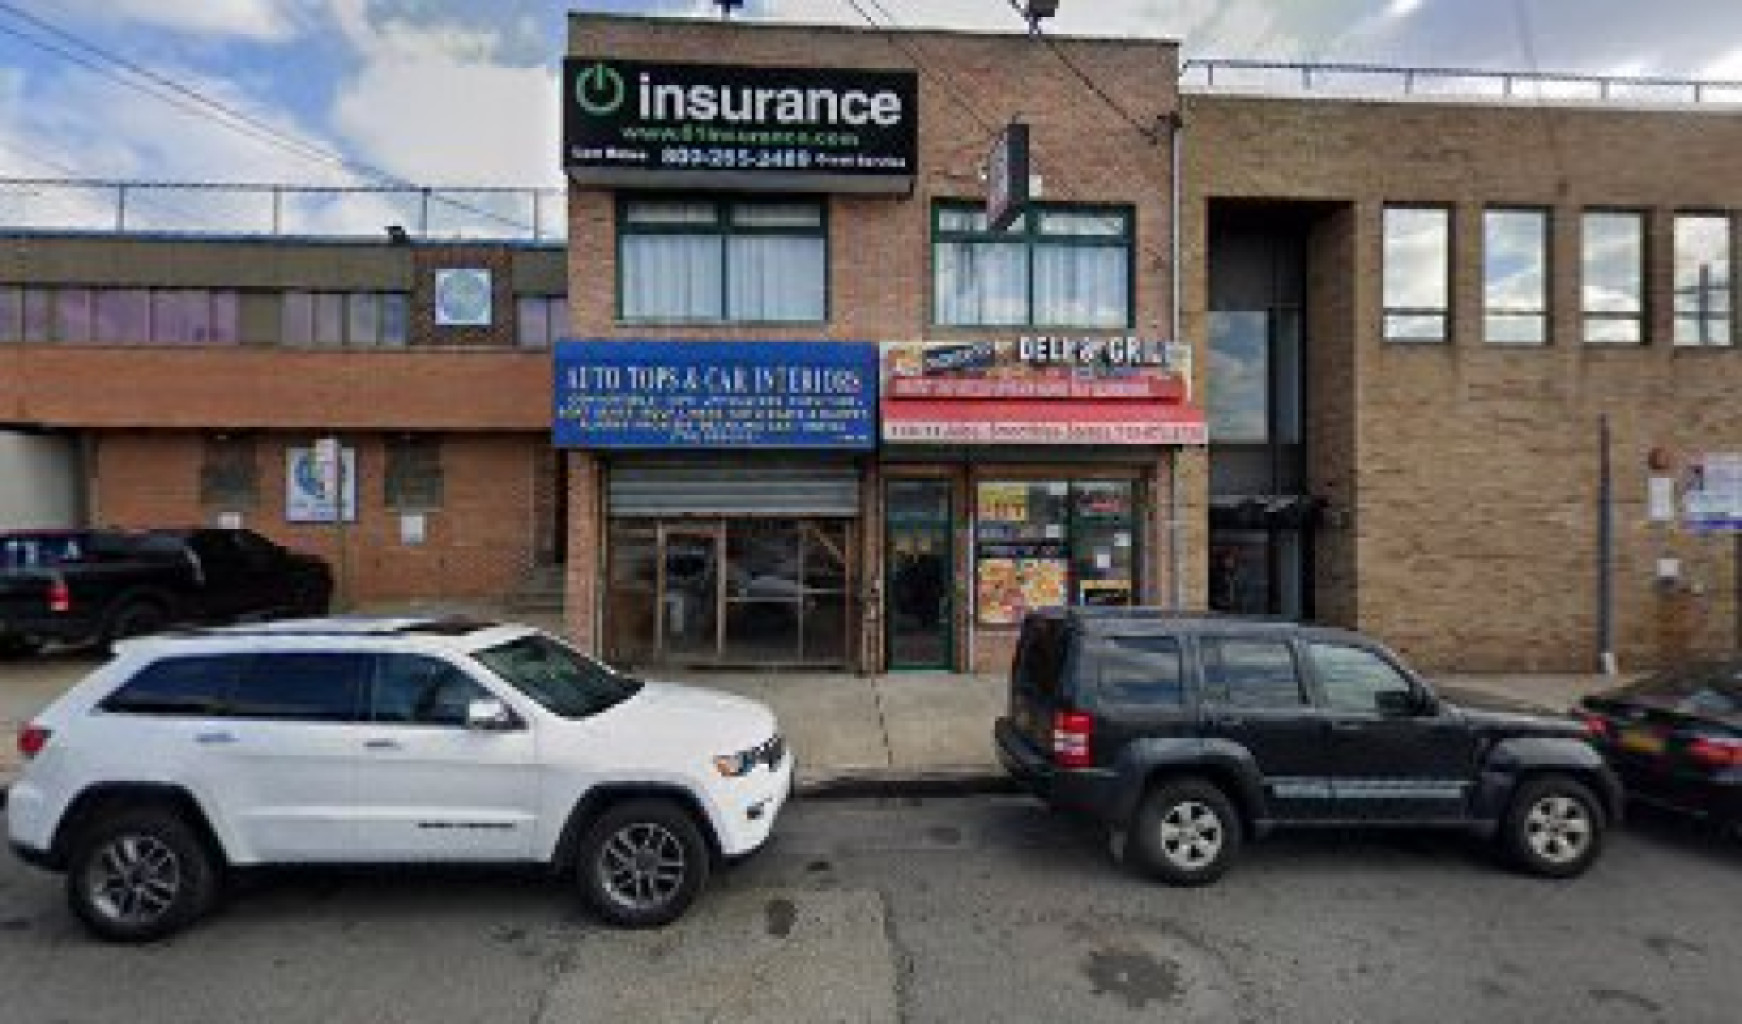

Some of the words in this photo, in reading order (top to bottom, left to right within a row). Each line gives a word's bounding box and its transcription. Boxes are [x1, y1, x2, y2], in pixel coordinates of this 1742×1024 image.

[638, 72, 902, 125] insurance
[567, 367, 620, 389] AUTO
[627, 367, 676, 392] TOPS
[704, 367, 749, 393] CAR
